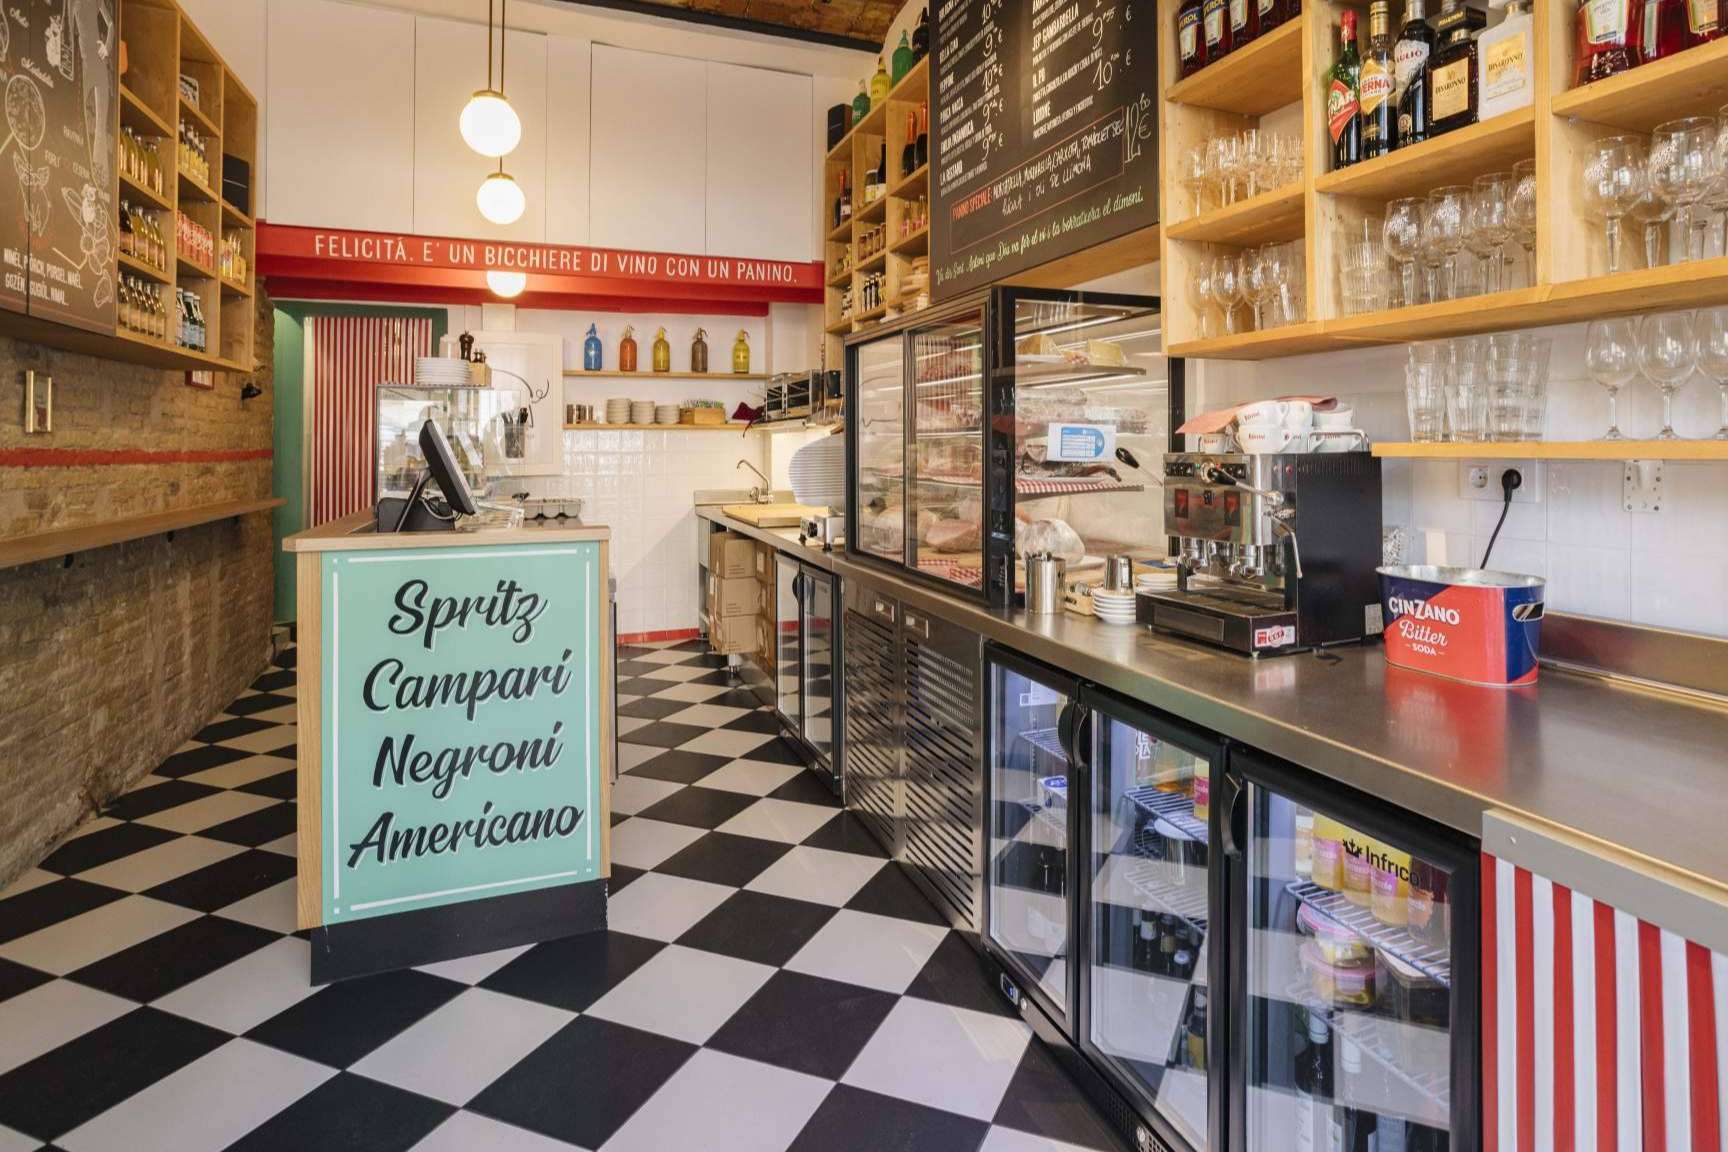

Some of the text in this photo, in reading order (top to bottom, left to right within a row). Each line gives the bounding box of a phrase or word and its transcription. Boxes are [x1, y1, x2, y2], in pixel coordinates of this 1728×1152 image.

[449, 243, 475, 265] UN
[485, 246, 582, 272] BICCHIERE
[591, 252, 608, 272] DI
[617, 253, 657, 274] VINO
[666, 257, 700, 277] CON
[707, 259, 730, 279] UN
[737, 261, 798, 284] PANINO.
[387, 579, 550, 652] Spritz
[1388, 596, 1460, 625] CINZANO
[1399, 618, 1448, 647] Bitter
[1411, 643, 1437, 656] SODA
[362, 648, 574, 722] Campari
[372, 721, 564, 800] Negroni
[347, 801, 586, 870] Americano
[1365, 845, 1420, 887] Infrico
